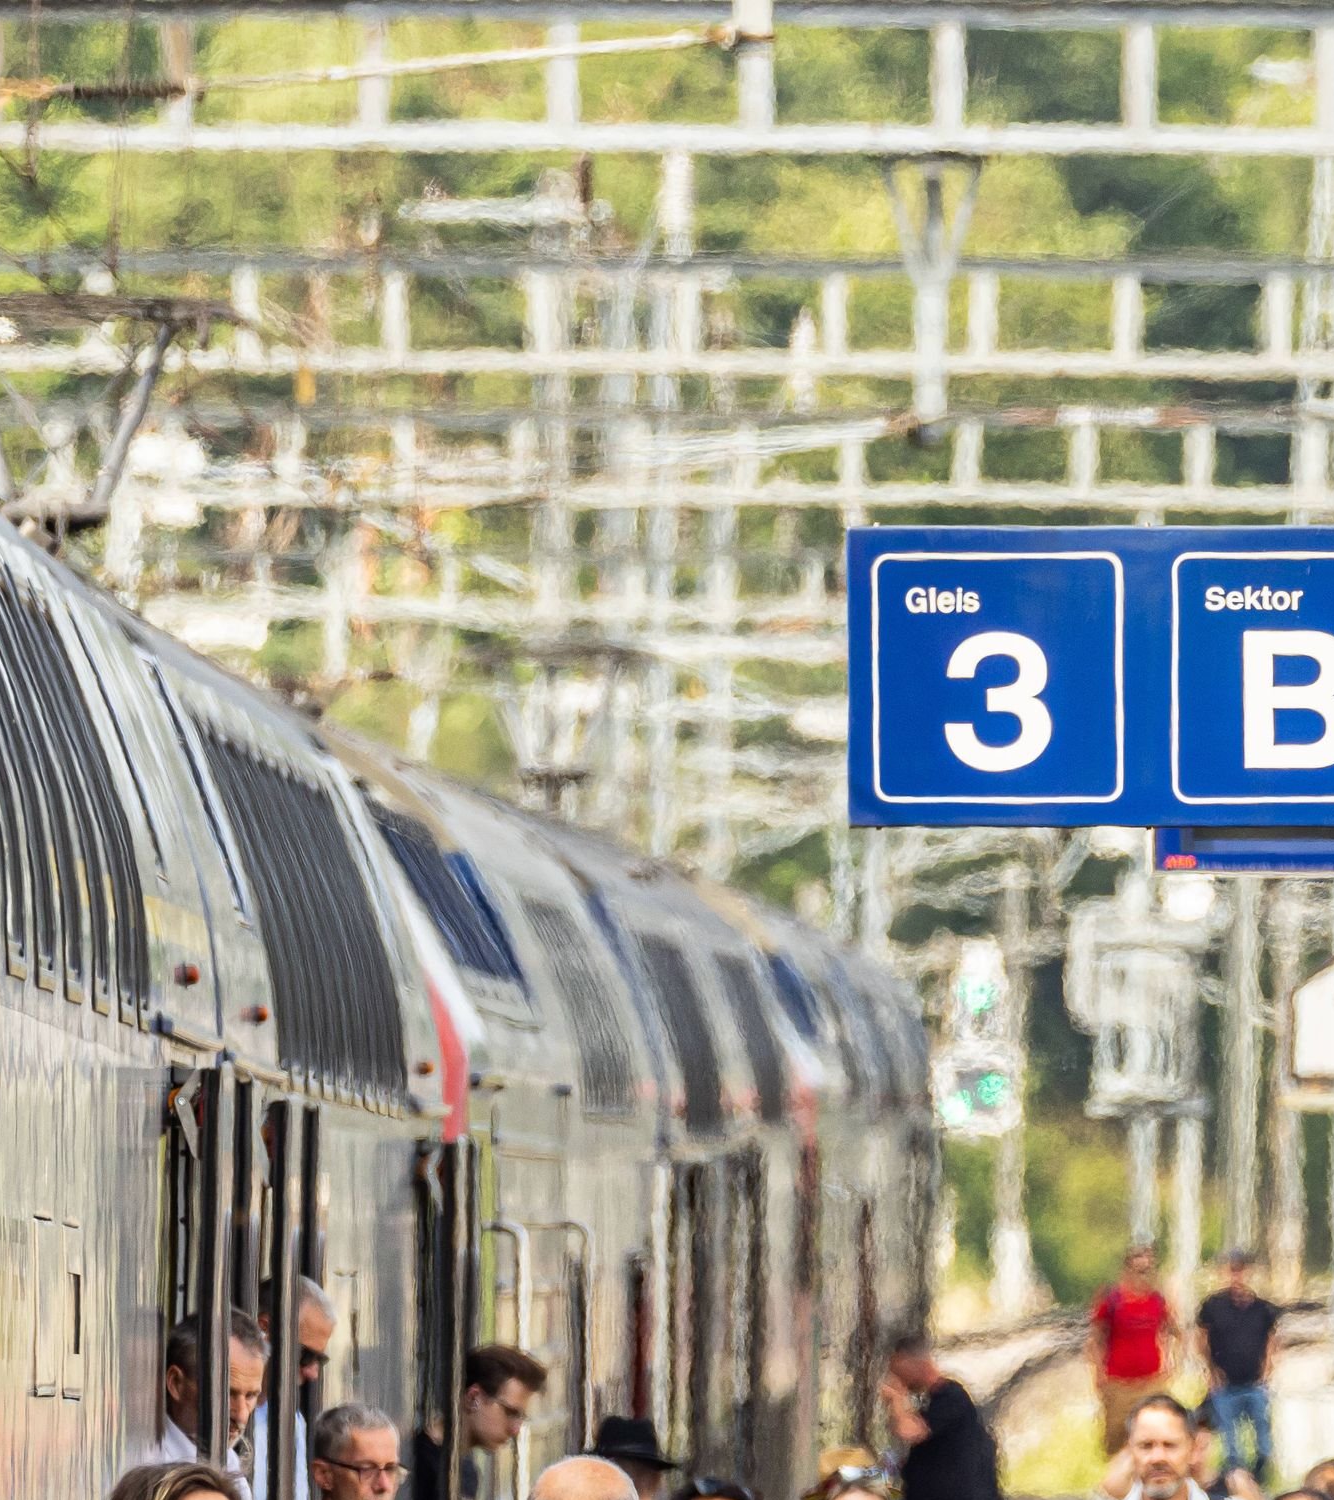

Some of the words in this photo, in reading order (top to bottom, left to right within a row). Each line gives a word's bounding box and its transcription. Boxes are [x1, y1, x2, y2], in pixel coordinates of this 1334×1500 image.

[905, 585, 981, 614] Gleis
[1204, 585, 1304, 612] Sektor
[943, 631, 1053, 772] 3
